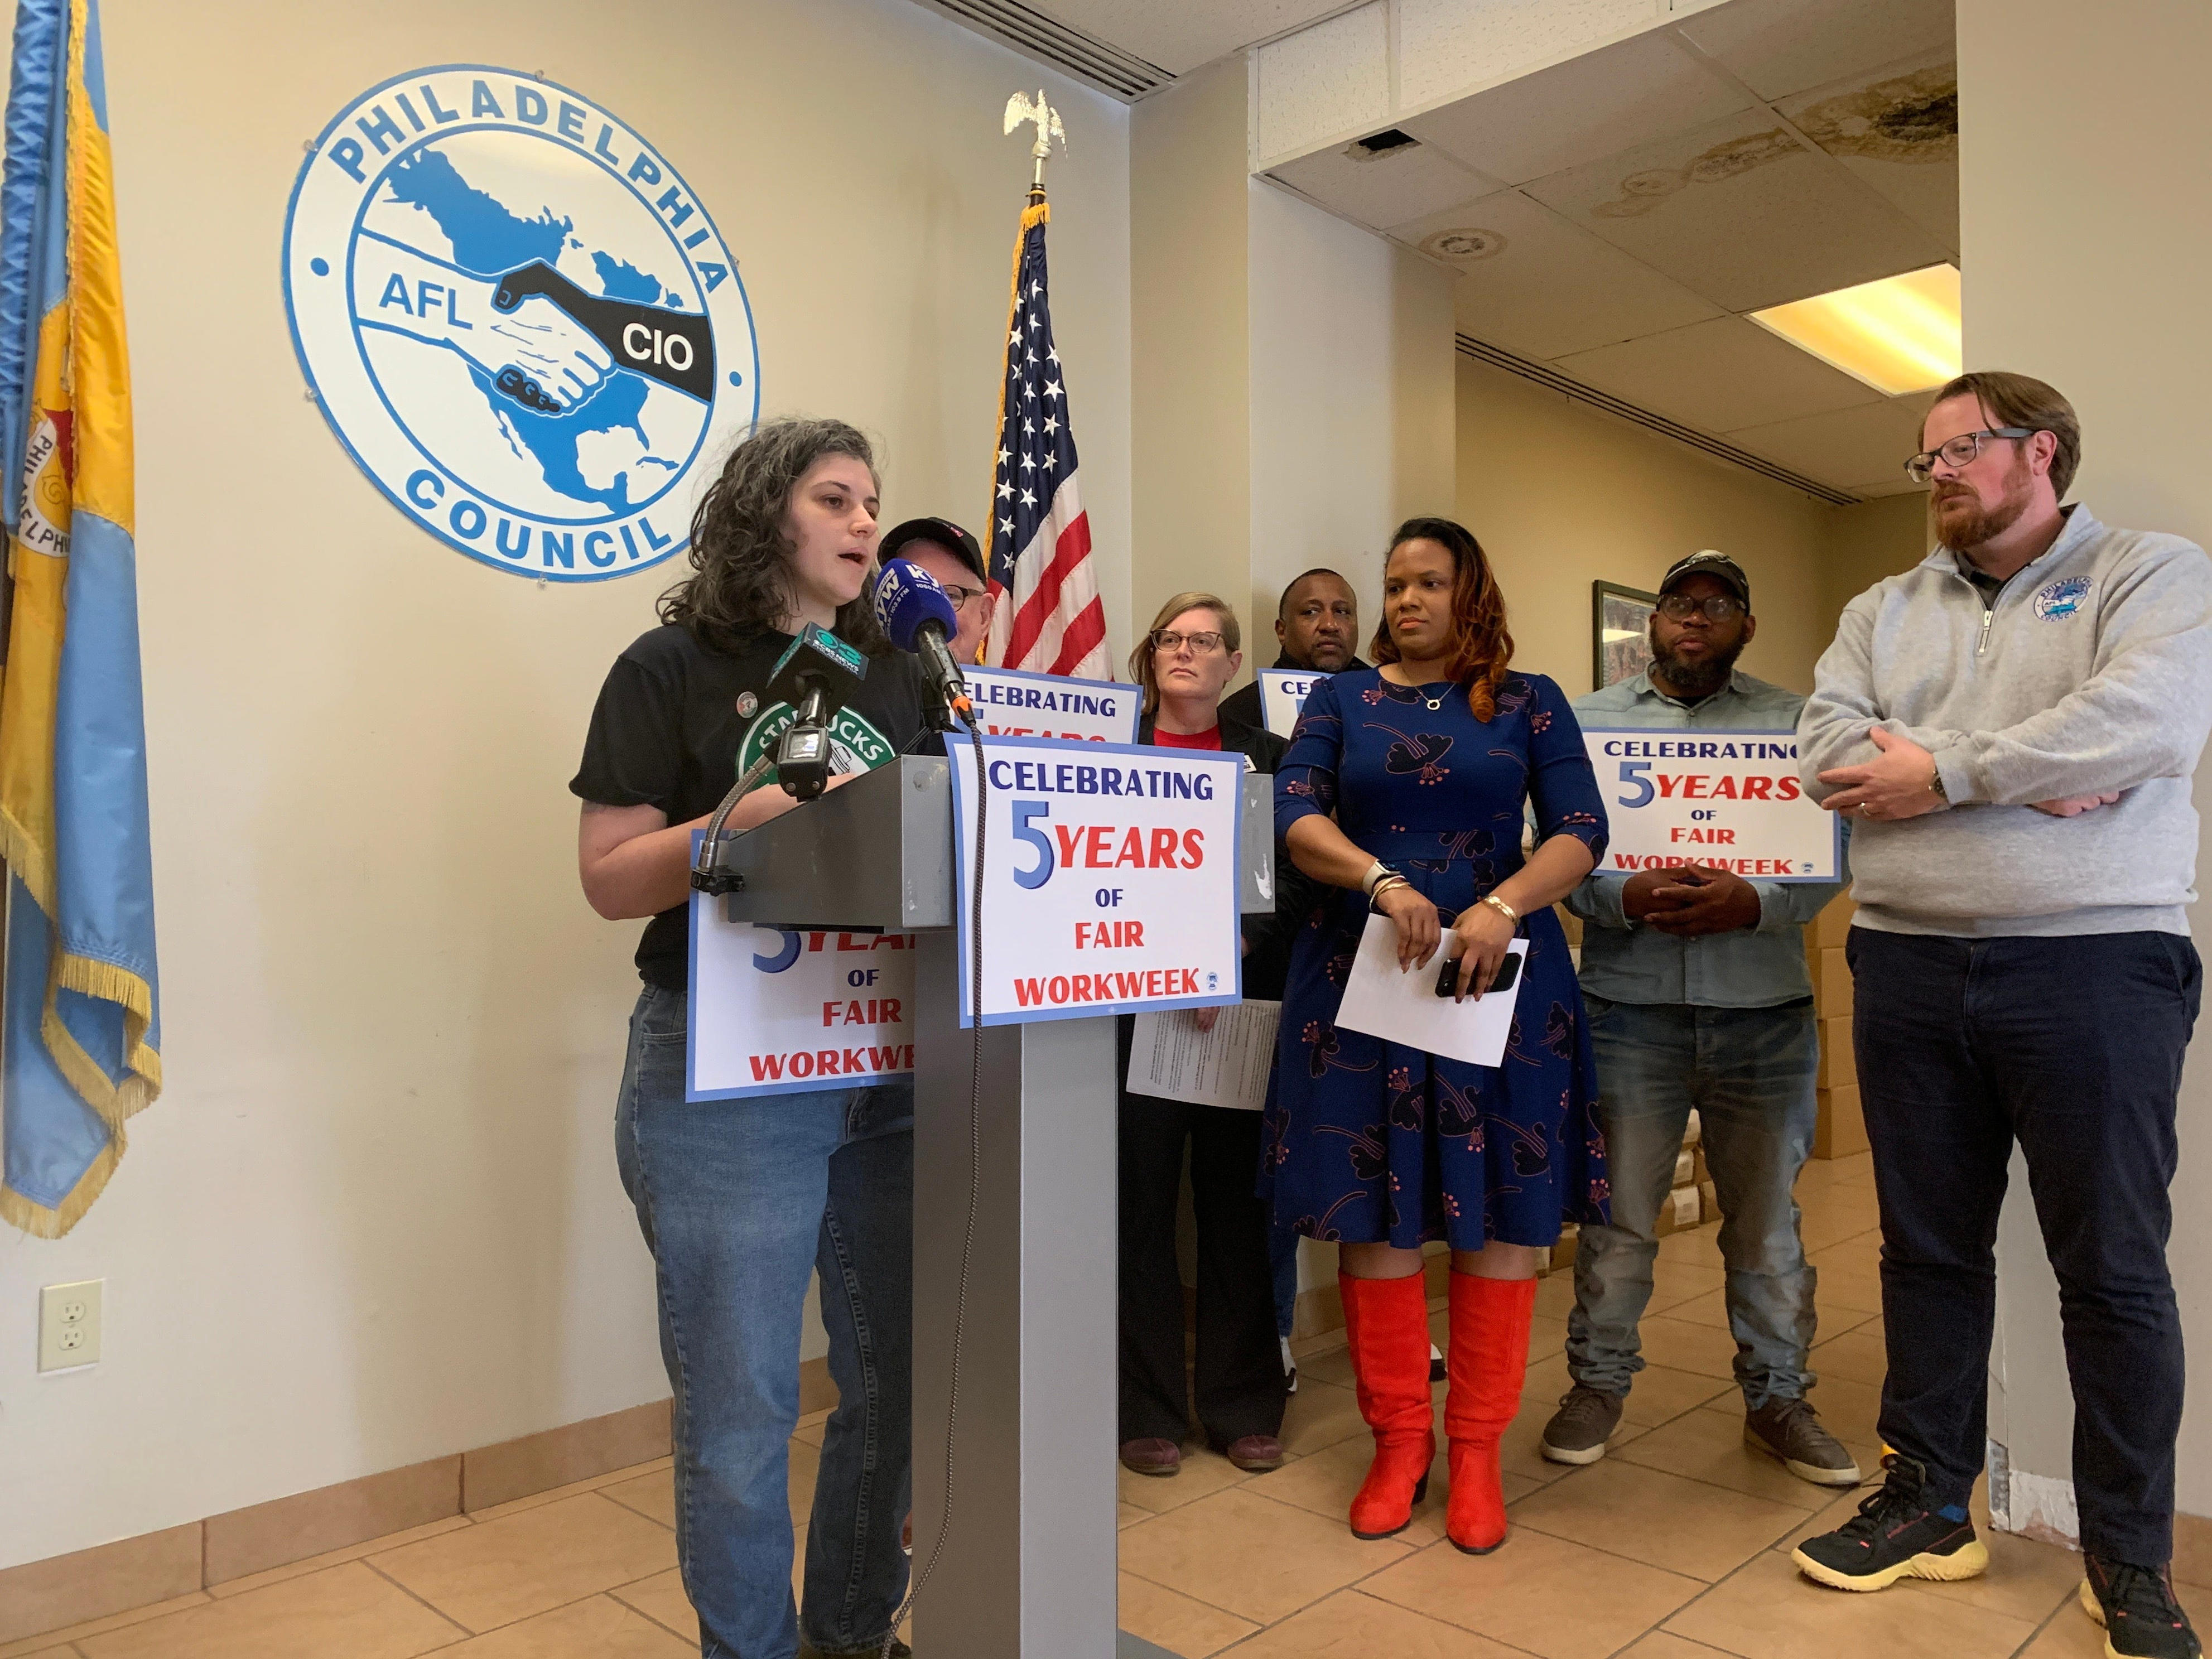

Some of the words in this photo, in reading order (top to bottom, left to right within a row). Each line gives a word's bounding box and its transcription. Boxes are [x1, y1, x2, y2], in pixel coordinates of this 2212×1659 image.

[329, 79, 729, 293] PHILADELPHIA
[379, 273, 473, 330] AFL
[623, 322, 693, 371] CIO
[406, 469, 673, 568] COUNCIL
[900, 587, 910, 597] FM
[820, 644, 835, 655] CBS
[836, 654, 859, 672] NEWS
[989, 760, 1213, 800] CELEBRATING
[1618, 761, 1655, 808] 5
[1656, 774, 1801, 800] YEARS
[1691, 809, 1717, 821] OF
[1011, 800, 1055, 890] 5
[1054, 824, 1205, 870] YEARS
[1670, 828, 1736, 845] FAIR
[1095, 888, 1124, 908] OF
[1074, 920, 1144, 949] FAIR
[847, 969, 880, 987] OF
[1014, 968, 1200, 1007] WORKWEEK
[823, 999, 902, 1027] FAIR
